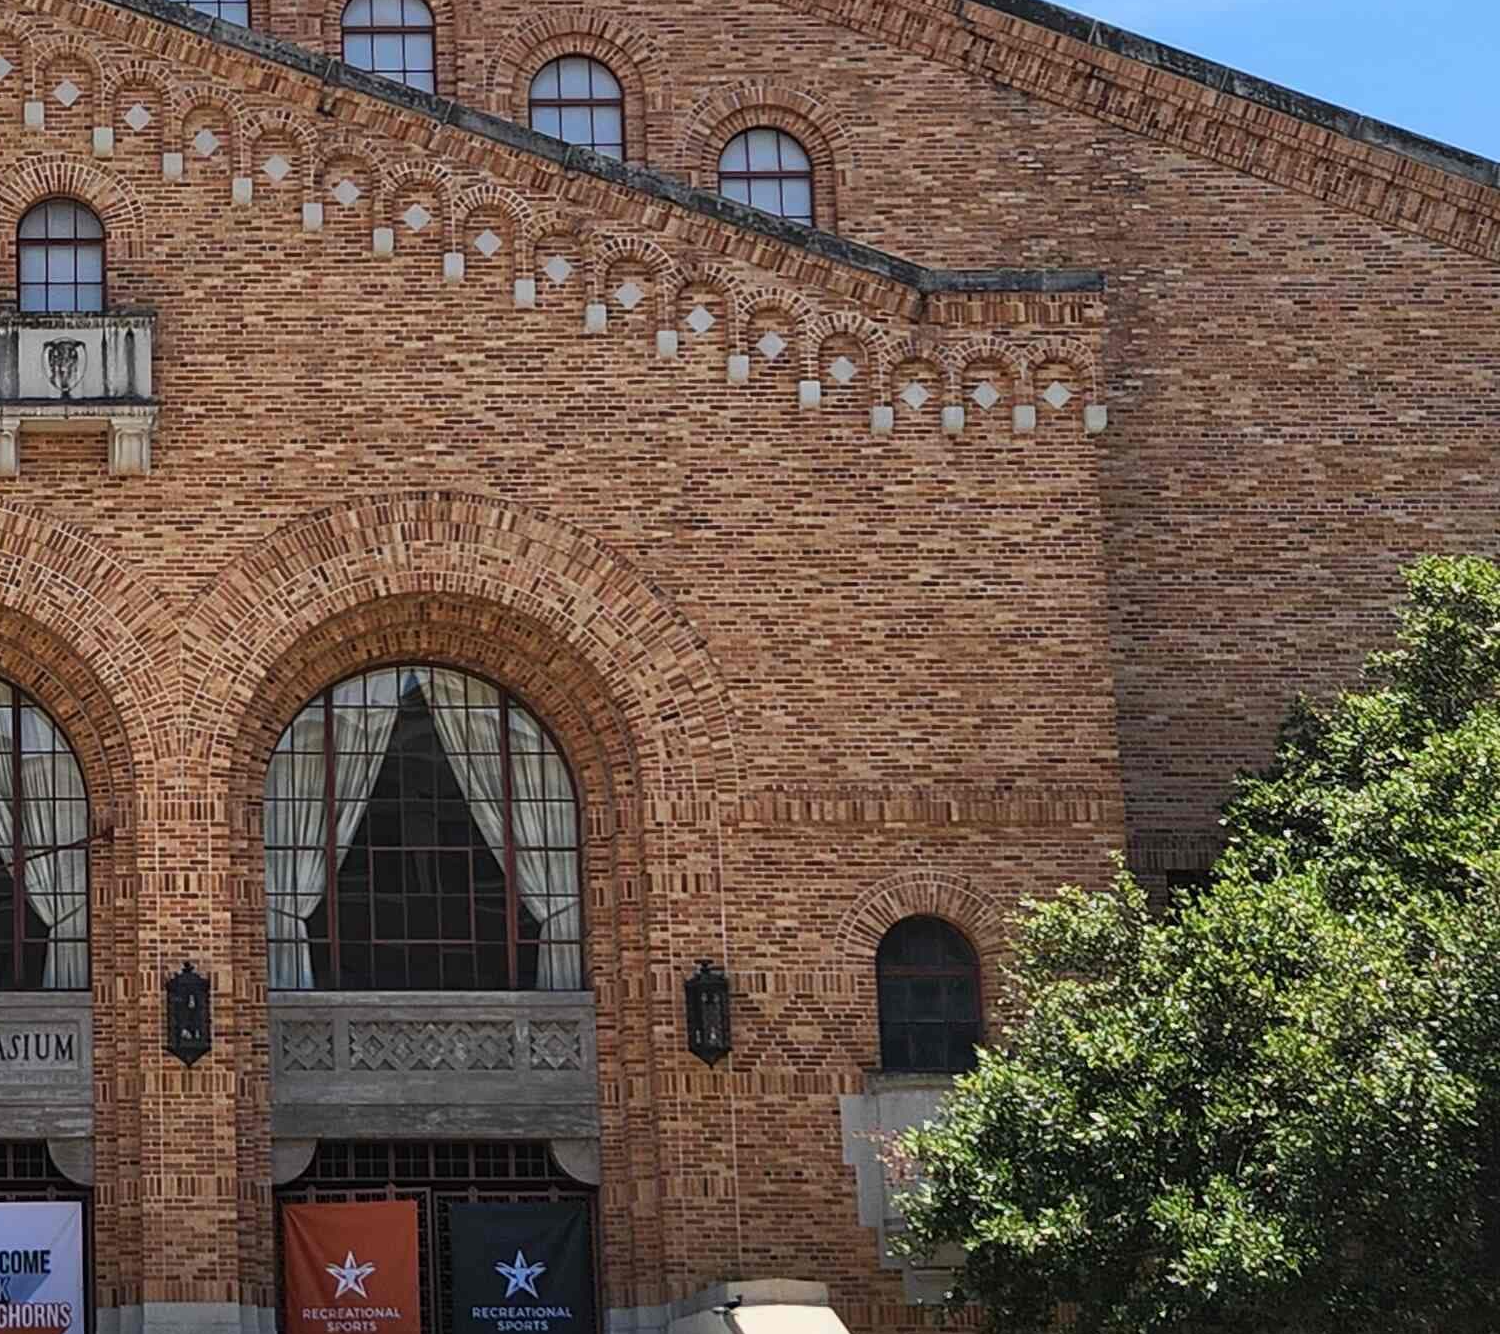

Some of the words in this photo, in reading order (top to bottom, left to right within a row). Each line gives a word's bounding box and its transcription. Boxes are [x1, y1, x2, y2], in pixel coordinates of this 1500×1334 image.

[302, 1307, 401, 1319] RECREATIONAL
[472, 1306, 572, 1319] RECREATIONAL
[327, 1320, 377, 1332] SPORTS
[497, 1320, 548, 1332] SPORTS
